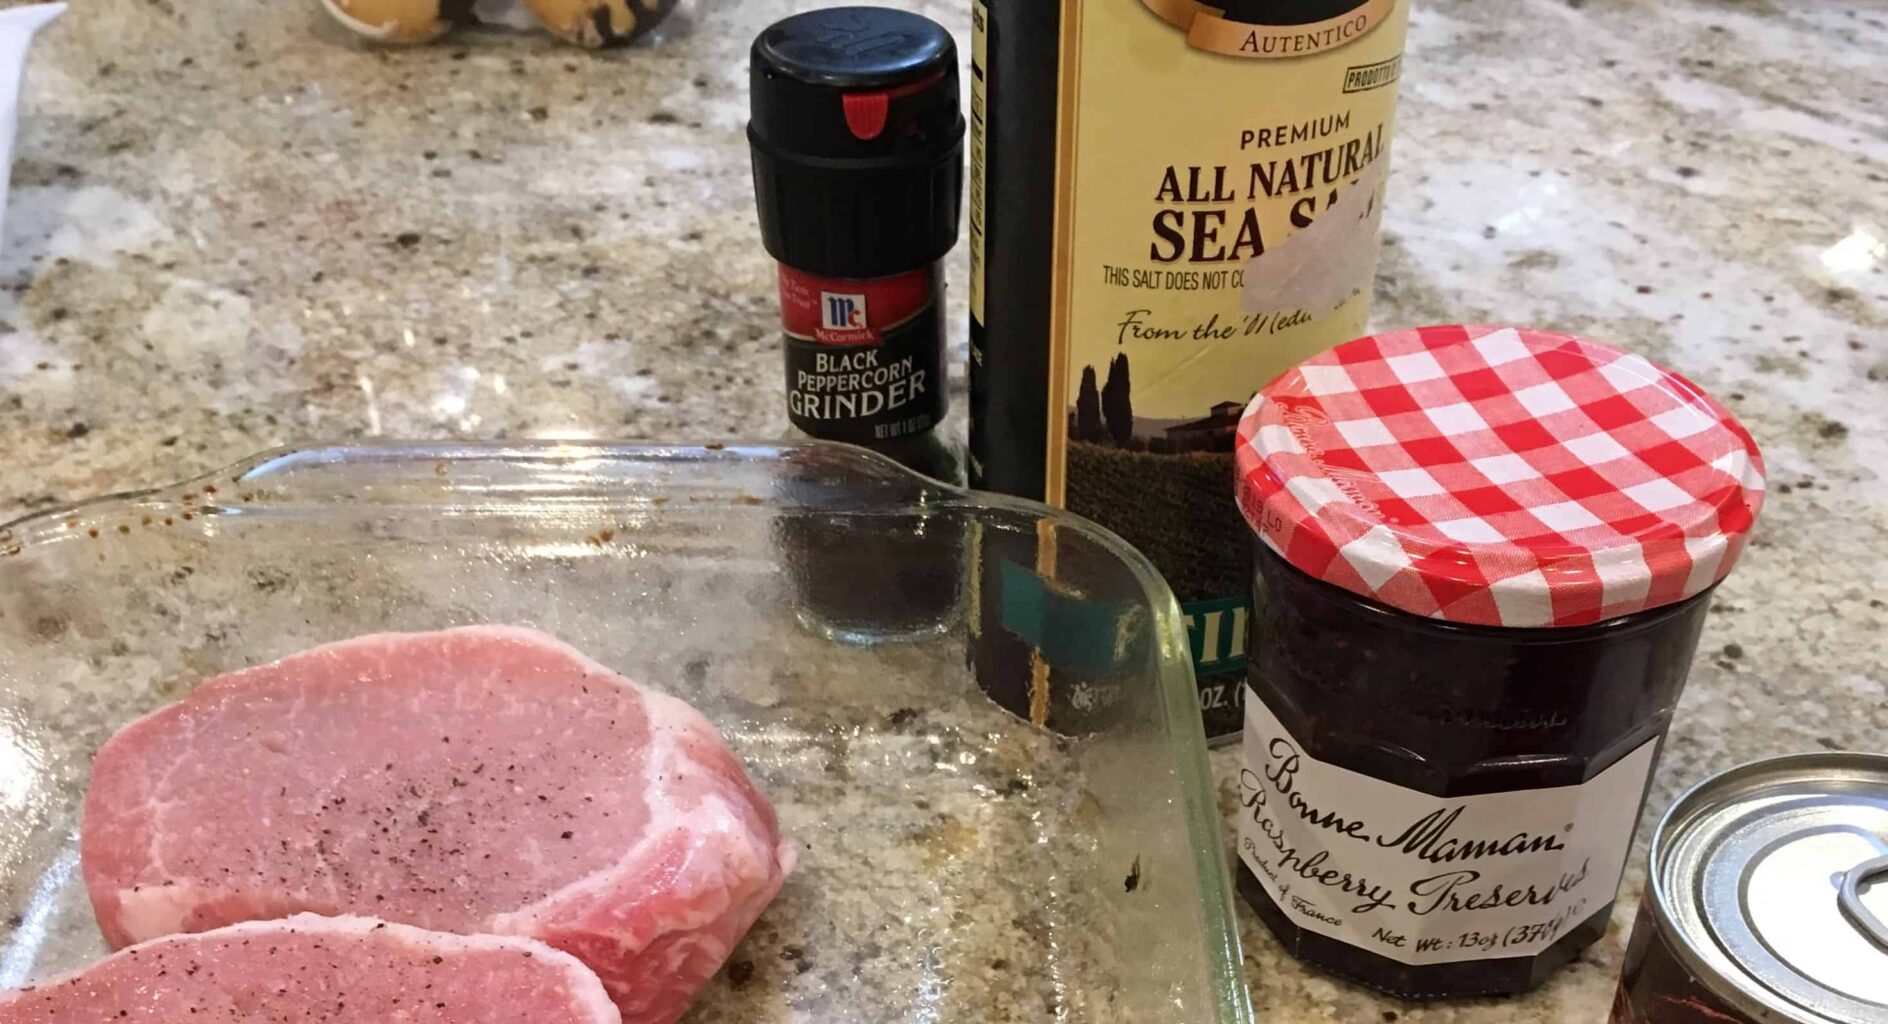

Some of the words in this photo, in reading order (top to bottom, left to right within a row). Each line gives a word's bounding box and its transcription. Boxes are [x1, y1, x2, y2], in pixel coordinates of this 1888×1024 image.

[1240, 14, 1367, 53] AUTENTICO
[1240, 110, 1350, 150] PREMIUM
[1155, 165, 1235, 202] ALL
[1247, 123, 1384, 200] NATURAL
[1151, 207, 1265, 263] SEA
[1103, 265, 1130, 287] THIS
[1132, 269, 1163, 289] SALT
[1165, 271, 1199, 290] DOES
[1202, 271, 1229, 290] NOT
[815, 327, 874, 343] McCormick
[1117, 309, 1187, 345] From
[1192, 313, 1237, 340] the
[798, 355, 913, 392] PEPPERCORN
[816, 349, 879, 373] BLACK
[790, 369, 926, 420] GRINDER
[1265, 738, 1370, 842] Bonne
[1376, 805, 1565, 864] Maman
[1240, 768, 1396, 914] Raspberry
[1407, 857, 1590, 915] Preserves
[1244, 836, 1278, 883] Product
[1278, 884, 1290, 902] of
[1291, 895, 1343, 927] France
[1372, 927, 1408, 948] Net
